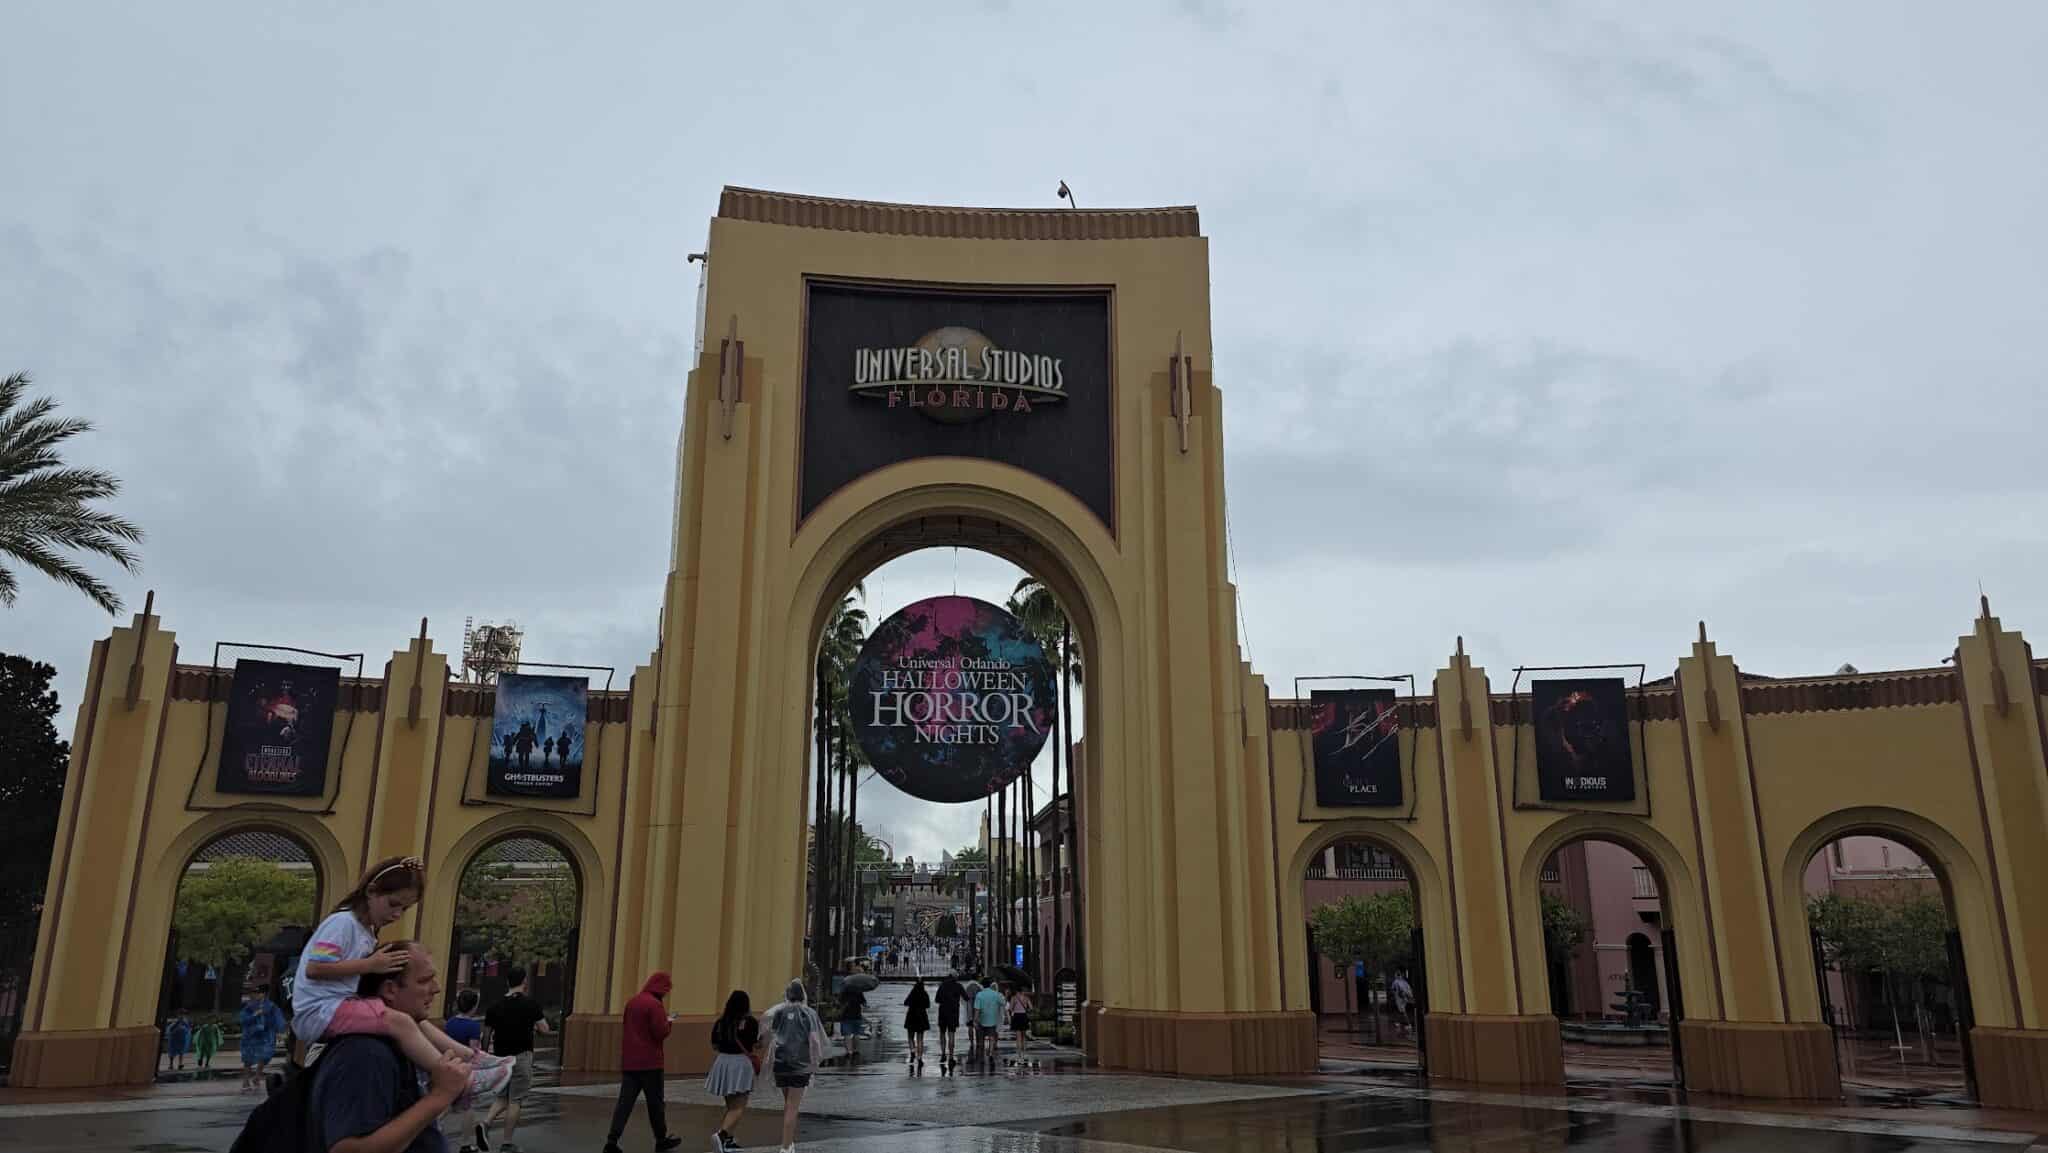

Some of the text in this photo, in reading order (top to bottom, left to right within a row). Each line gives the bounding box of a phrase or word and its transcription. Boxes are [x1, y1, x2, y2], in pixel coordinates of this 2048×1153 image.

[854, 345, 1063, 390] UNIVERSAL STUDIOS
[887, 390, 1032, 412] FLORIDA
[899, 656, 1011, 670] Universal Orlando
[881, 670, 1027, 691] HALLOWEEN
[867, 690, 1041, 735] HORROR
[913, 725, 1000, 744] NIGHTS
[1349, 785, 1378, 793] PLACE
